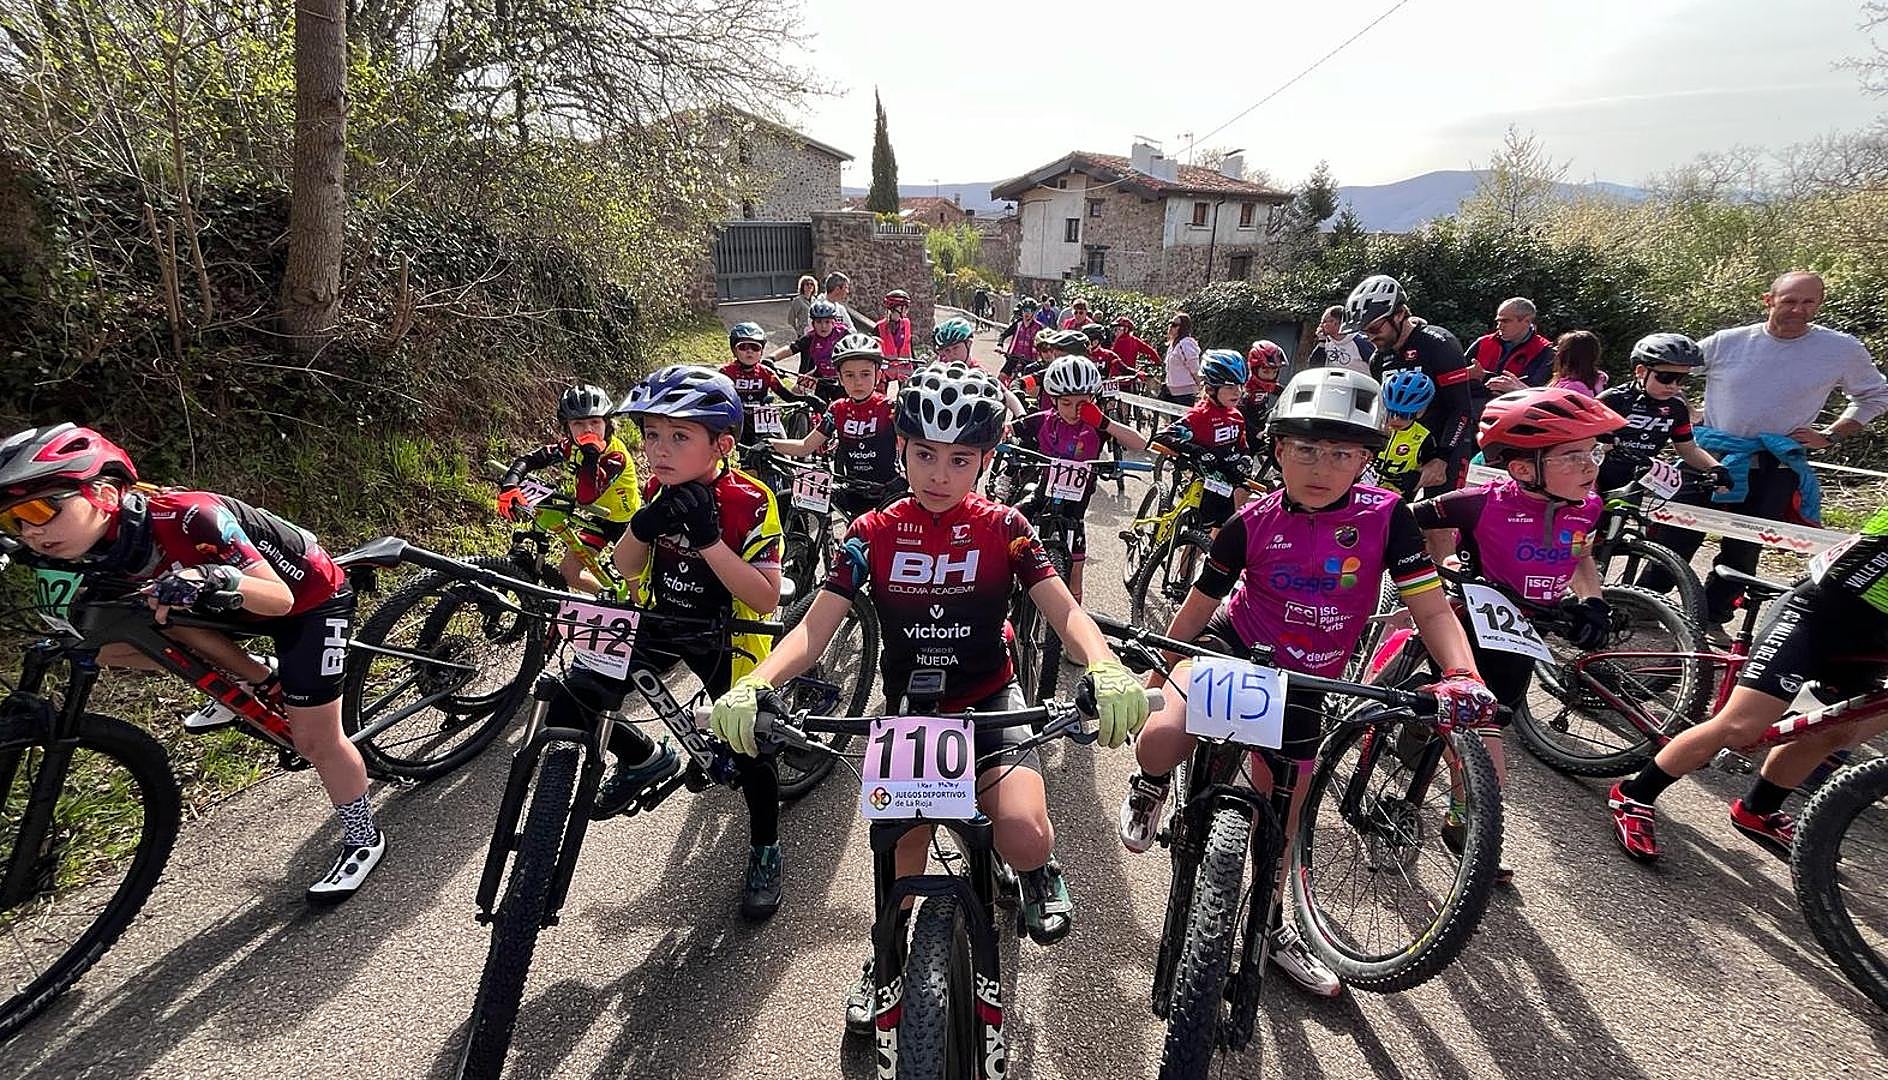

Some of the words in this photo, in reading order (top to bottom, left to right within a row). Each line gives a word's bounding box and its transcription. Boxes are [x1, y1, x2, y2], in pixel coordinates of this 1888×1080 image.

[736, 379, 763, 389] BH
[843, 417, 877, 435] BH
[1215, 425, 1240, 443] BH
[1626, 414, 1674, 432] BH
[1052, 464, 1088, 489] 118
[1653, 461, 1680, 488] 113
[1355, 492, 1384, 505] ISC
[256, 539, 305, 582] SHIMANO
[888, 549, 981, 585] BH
[1845, 563, 1881, 588] VALLE
[561, 609, 627, 658] 112
[903, 622, 971, 639] victoria
[1764, 622, 1797, 648] VALLE
[320, 617, 350, 677] BH
[1753, 645, 1778, 662] DEL
[916, 654, 959, 667] HUEDA
[1742, 661, 1766, 679] OJA
[1194, 667, 1271, 721] 115
[631, 668, 714, 770] ORBEA
[874, 725, 968, 780] 110
[895, 791, 922, 799] JUEGOS
[922, 790, 967, 799] DEPORTIVOS
[915, 799, 933, 808] Rioja
[877, 975, 904, 1007] 32
[976, 972, 1001, 1002] 32
